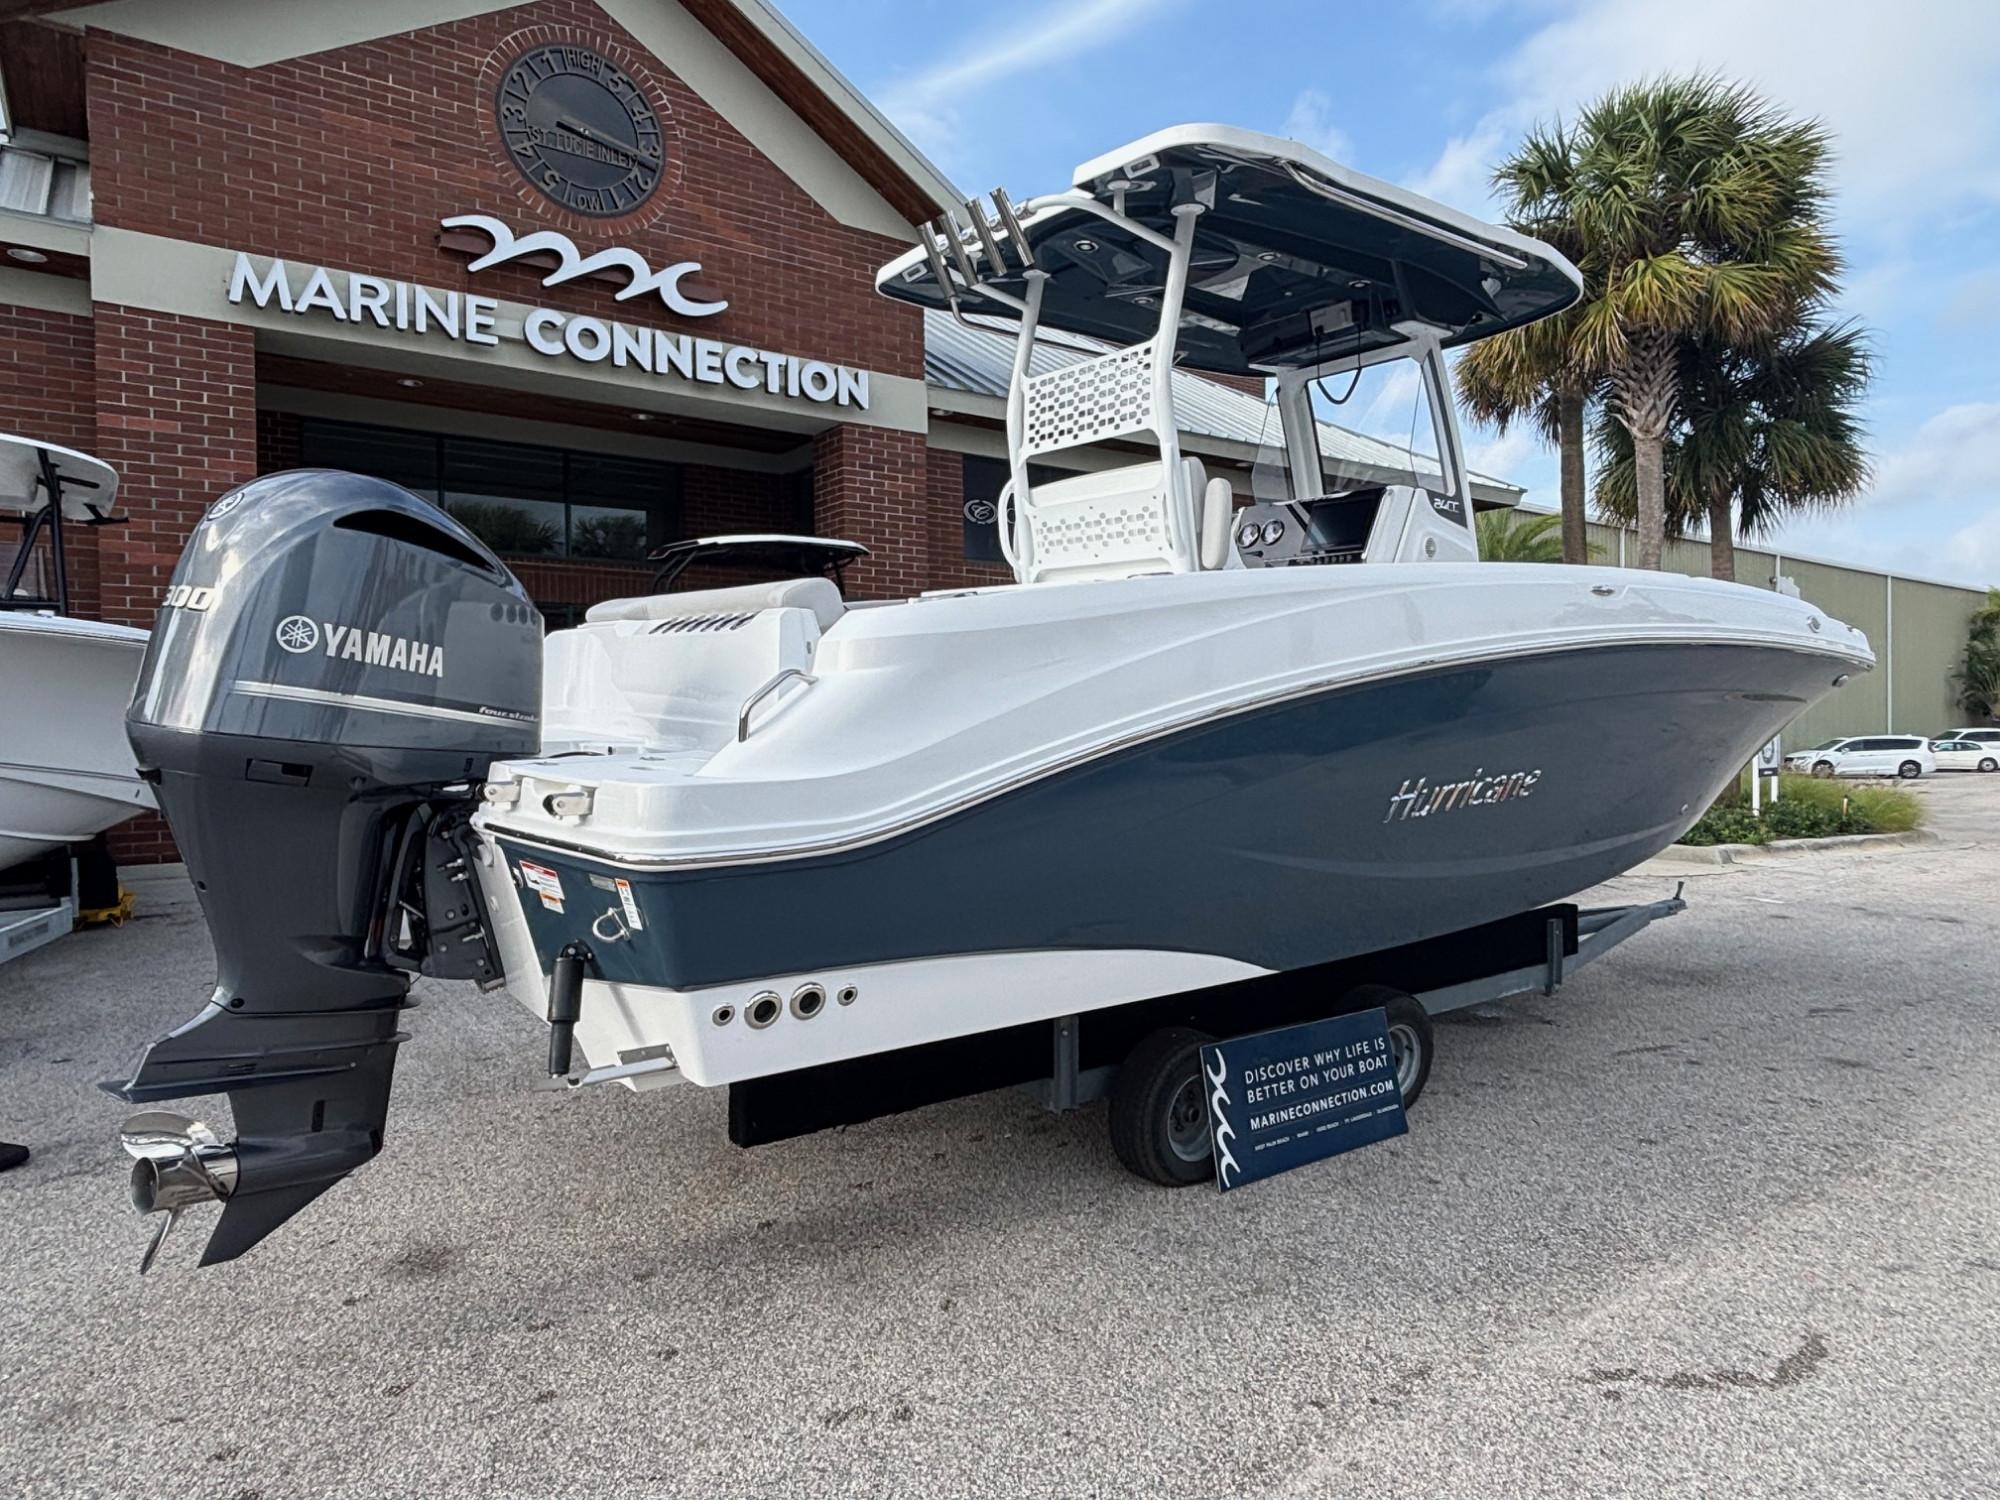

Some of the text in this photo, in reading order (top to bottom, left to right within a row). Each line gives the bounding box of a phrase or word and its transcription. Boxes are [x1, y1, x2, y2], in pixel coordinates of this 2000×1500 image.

[567, 49, 601, 76] HIGH
[557, 134, 594, 158] LUCIE
[569, 191, 600, 212] LOW
[228, 252, 869, 410] MARINE CONNECTION
[162, 585, 216, 611] 300
[324, 622, 443, 678] YAMAHA
[1383, 767, 1542, 824] Hurricane
[1244, 1037, 1385, 1084] DISCOVER WHY LIFE IS
[1247, 1054, 1388, 1104] BETTER ON YOUR BOAT
[1250, 1079, 1394, 1131] MARINECONNECTION.COM
